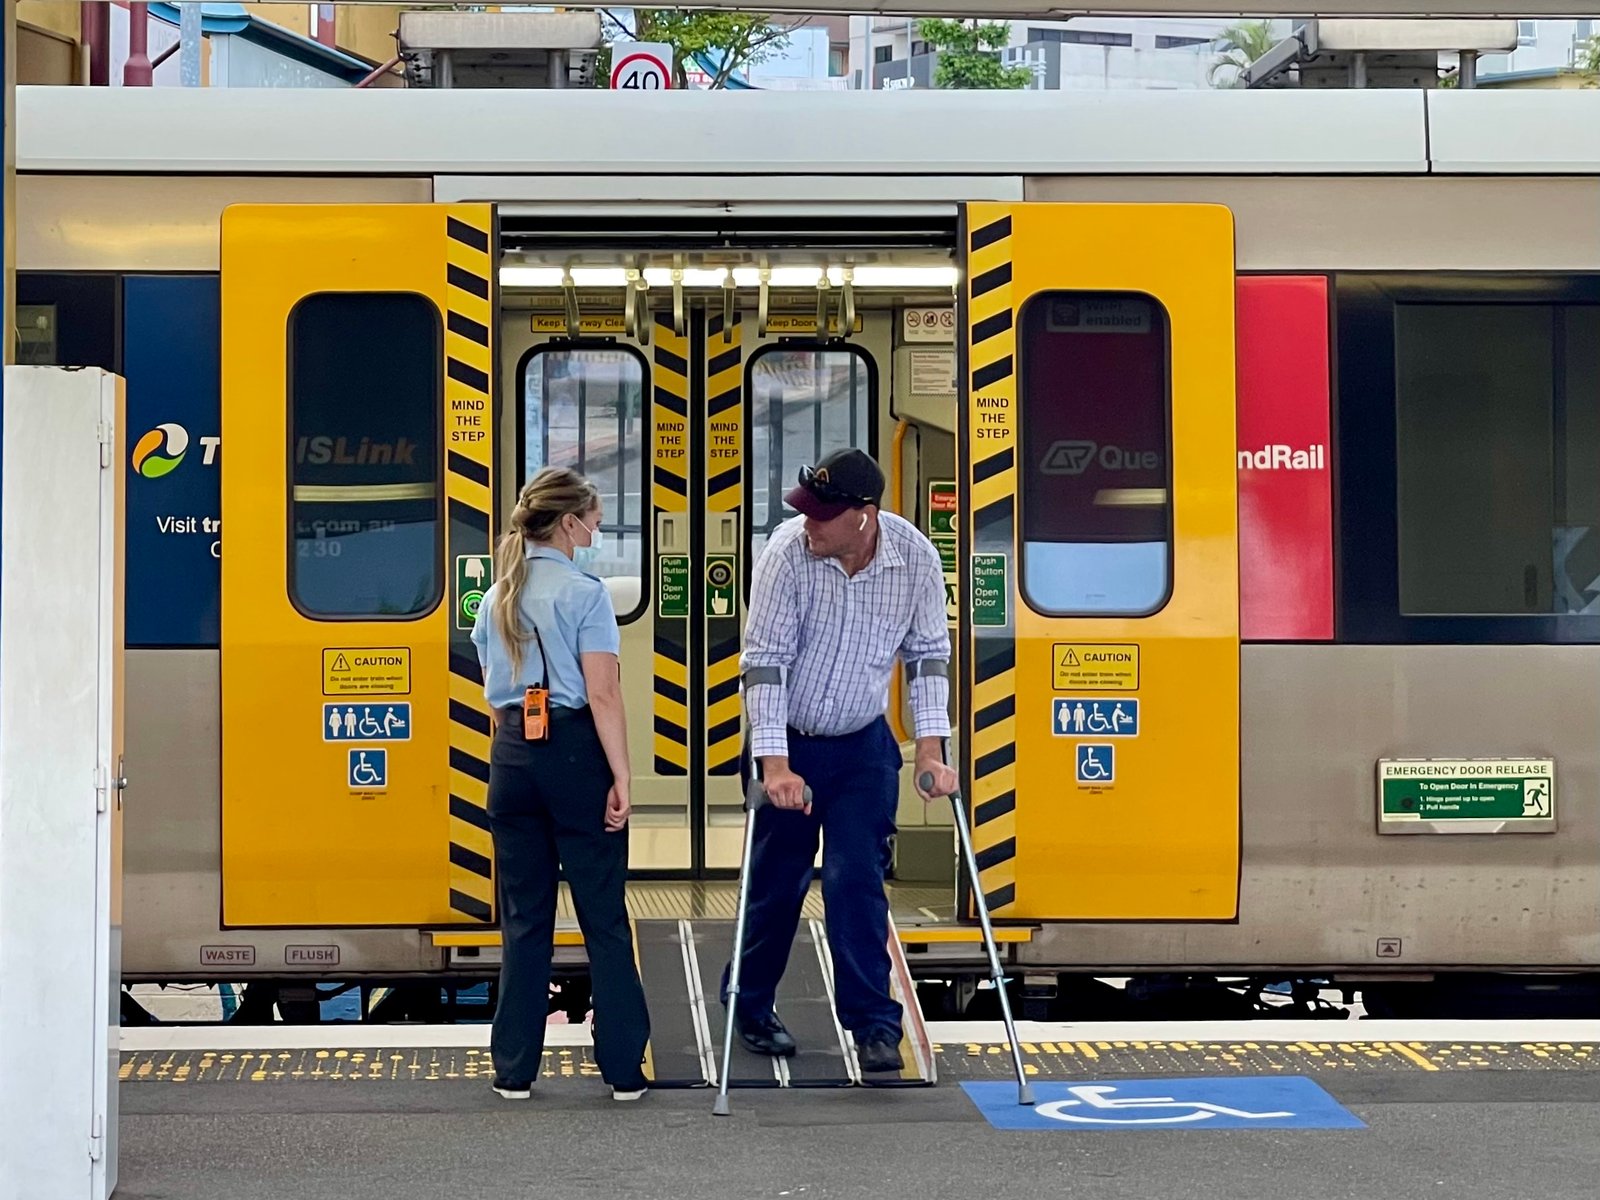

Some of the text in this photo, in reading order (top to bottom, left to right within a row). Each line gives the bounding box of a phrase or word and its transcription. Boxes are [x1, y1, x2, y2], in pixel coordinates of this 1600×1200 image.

[622, 71, 659, 89] 40
[537, 319, 560, 328] Keep
[605, 319, 625, 327] Clea
[767, 319, 789, 328] Keep
[1086, 314, 1141, 325] enabled
[452, 400, 485, 410] MIND
[977, 398, 1009, 407] MIND
[456, 416, 481, 426] THE
[980, 413, 1005, 423] THE
[657, 423, 684, 432] MIND
[711, 423, 738, 432] MIND
[452, 431, 485, 441] STEP
[977, 428, 1009, 438] STEP
[660, 436, 681, 445] THE
[714, 436, 735, 445] THE
[657, 449, 684, 458] STEP
[711, 449, 738, 458] STEP
[1238, 445, 1324, 469] ndRail
[156, 516, 197, 533] Visit
[975, 557, 996, 565] Push
[975, 567, 1003, 575] Button
[663, 584, 683, 592] Open
[975, 588, 998, 597] Open
[975, 598, 996, 606] Door
[354, 657, 402, 666] CAUTION
[1084, 653, 1131, 661] CAUTION
[1386, 765, 1547, 775] EMERGENCY DOOR RELEASE
[1430, 783, 1449, 791] Open
[1479, 782, 1519, 791] Emergency
[205, 951, 250, 960] WASTE
[292, 951, 333, 960] FLUSH
